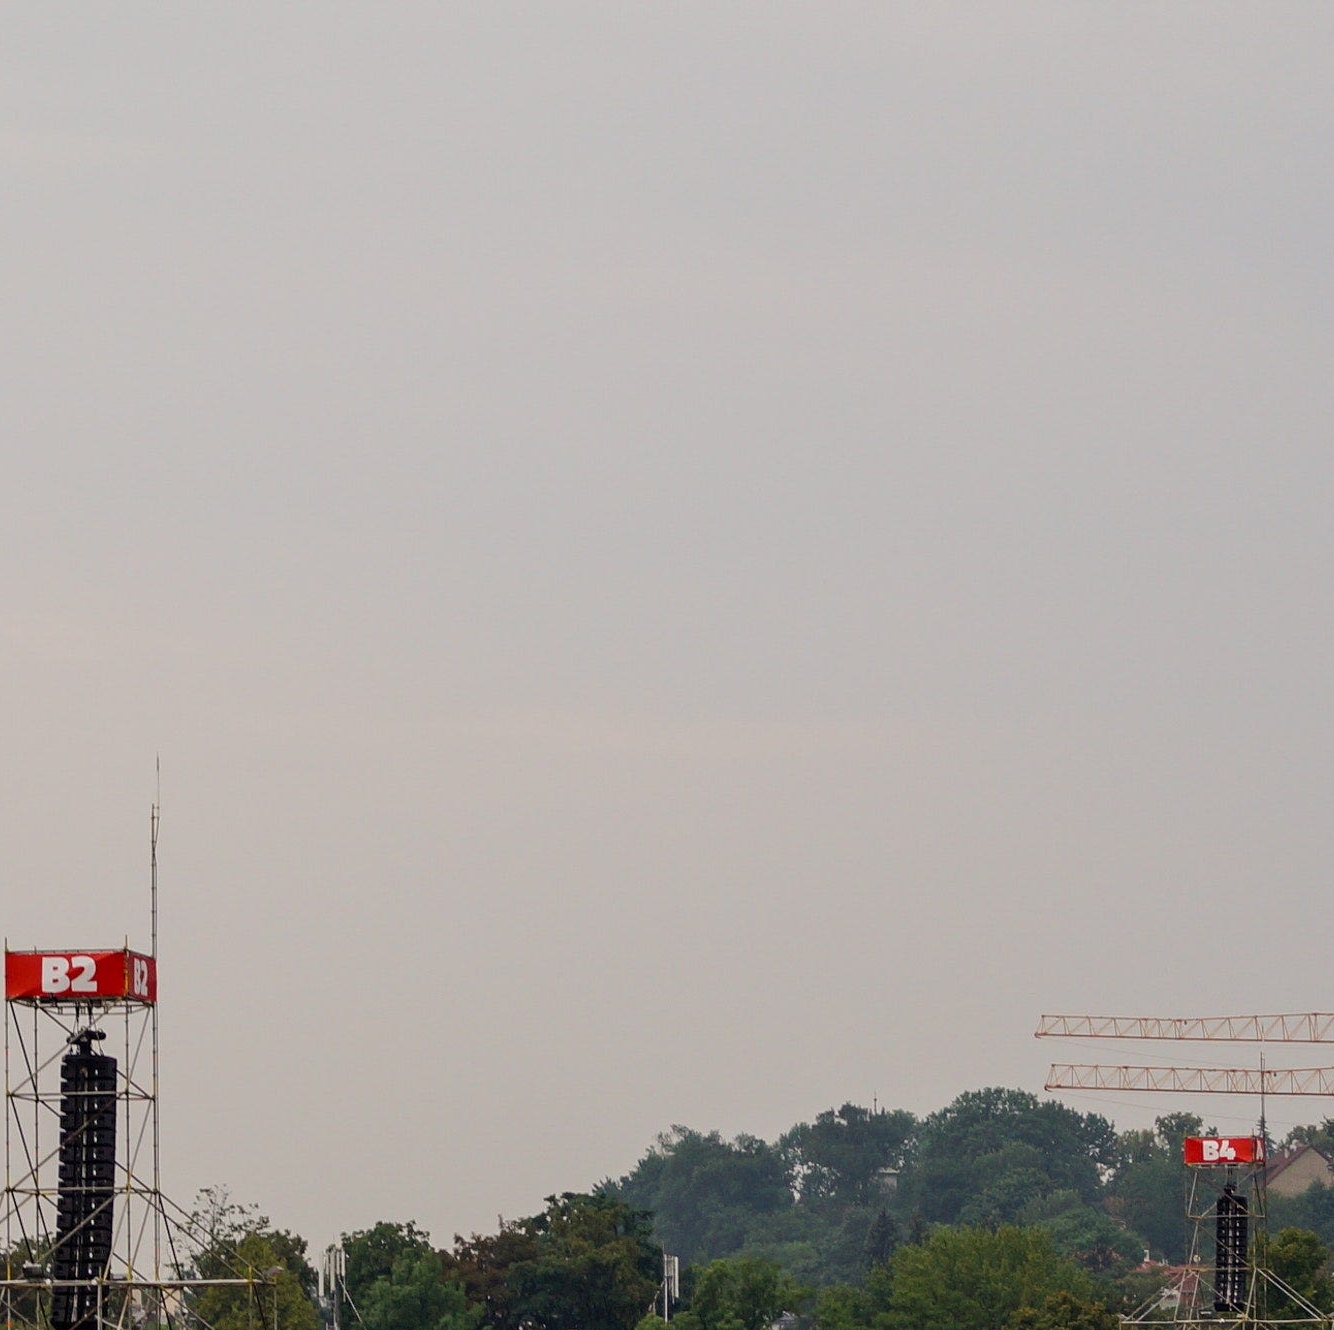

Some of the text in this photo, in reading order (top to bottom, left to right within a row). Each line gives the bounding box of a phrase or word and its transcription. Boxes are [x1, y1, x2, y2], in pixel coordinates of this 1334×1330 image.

[42, 955, 98, 993] B2
[133, 957, 149, 996] B2
[1202, 1139, 1236, 1161] B4
